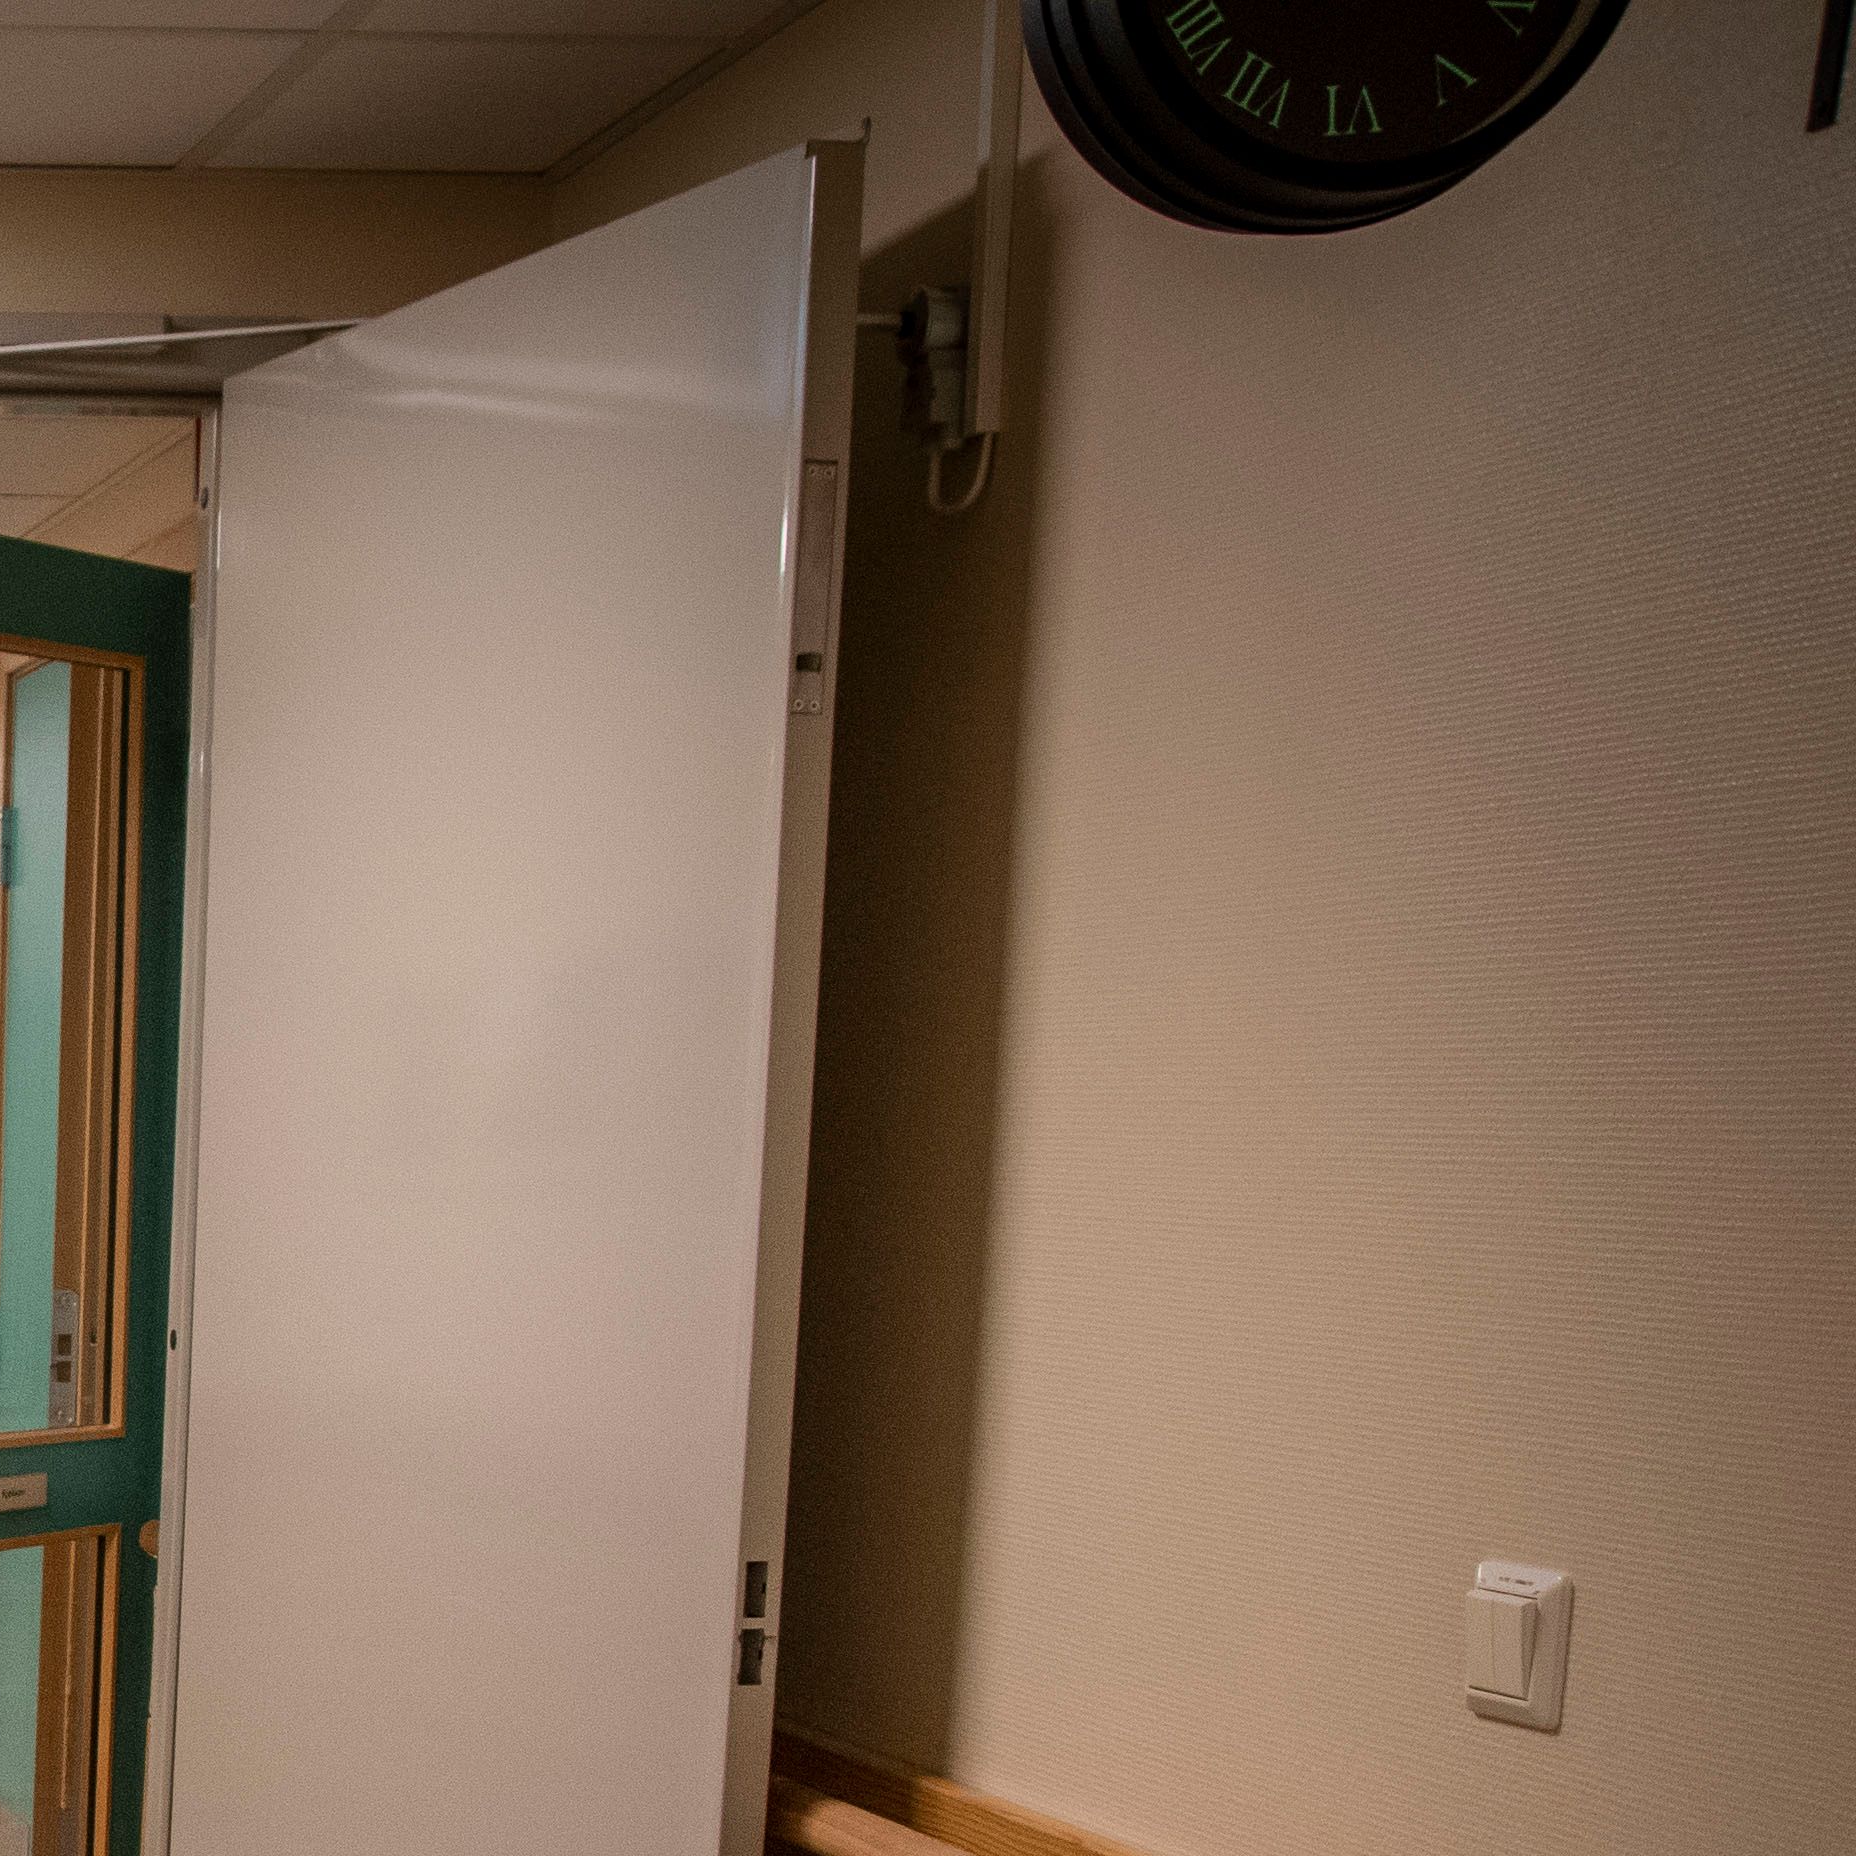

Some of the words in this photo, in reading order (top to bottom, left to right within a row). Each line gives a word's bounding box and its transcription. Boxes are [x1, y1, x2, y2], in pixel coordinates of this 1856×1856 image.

[1222, 50, 1291, 128] VII
[1434, 53, 1478, 108] V
[1323, 84, 1383, 137] VI
